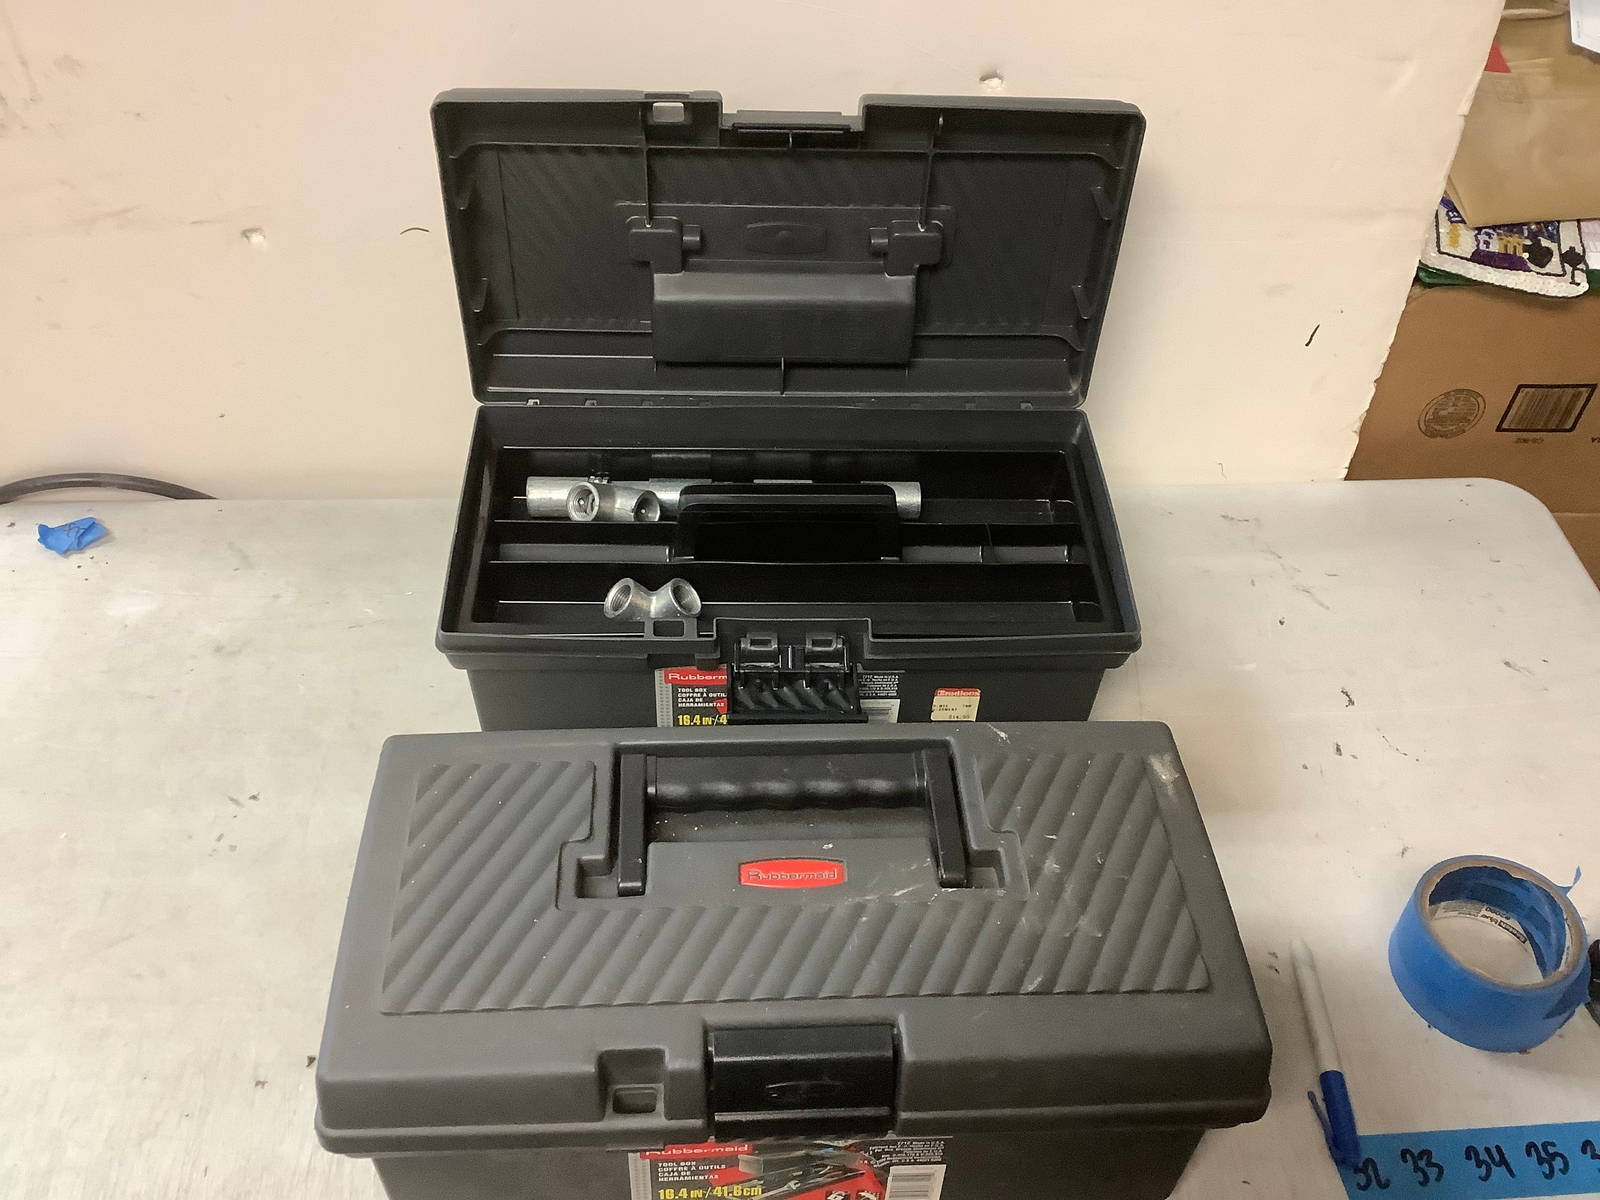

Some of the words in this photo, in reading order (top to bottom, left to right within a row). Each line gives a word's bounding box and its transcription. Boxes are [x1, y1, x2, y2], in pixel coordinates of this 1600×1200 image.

[677, 714, 701, 726] 16.4
[748, 868, 838, 881] Rubbermaid
[1400, 1148, 1445, 1187] 33
[1464, 1144, 1517, 1182] 34
[1525, 1140, 1570, 1180] 35
[658, 1174, 720, 1182] HERRAMIENTAS
